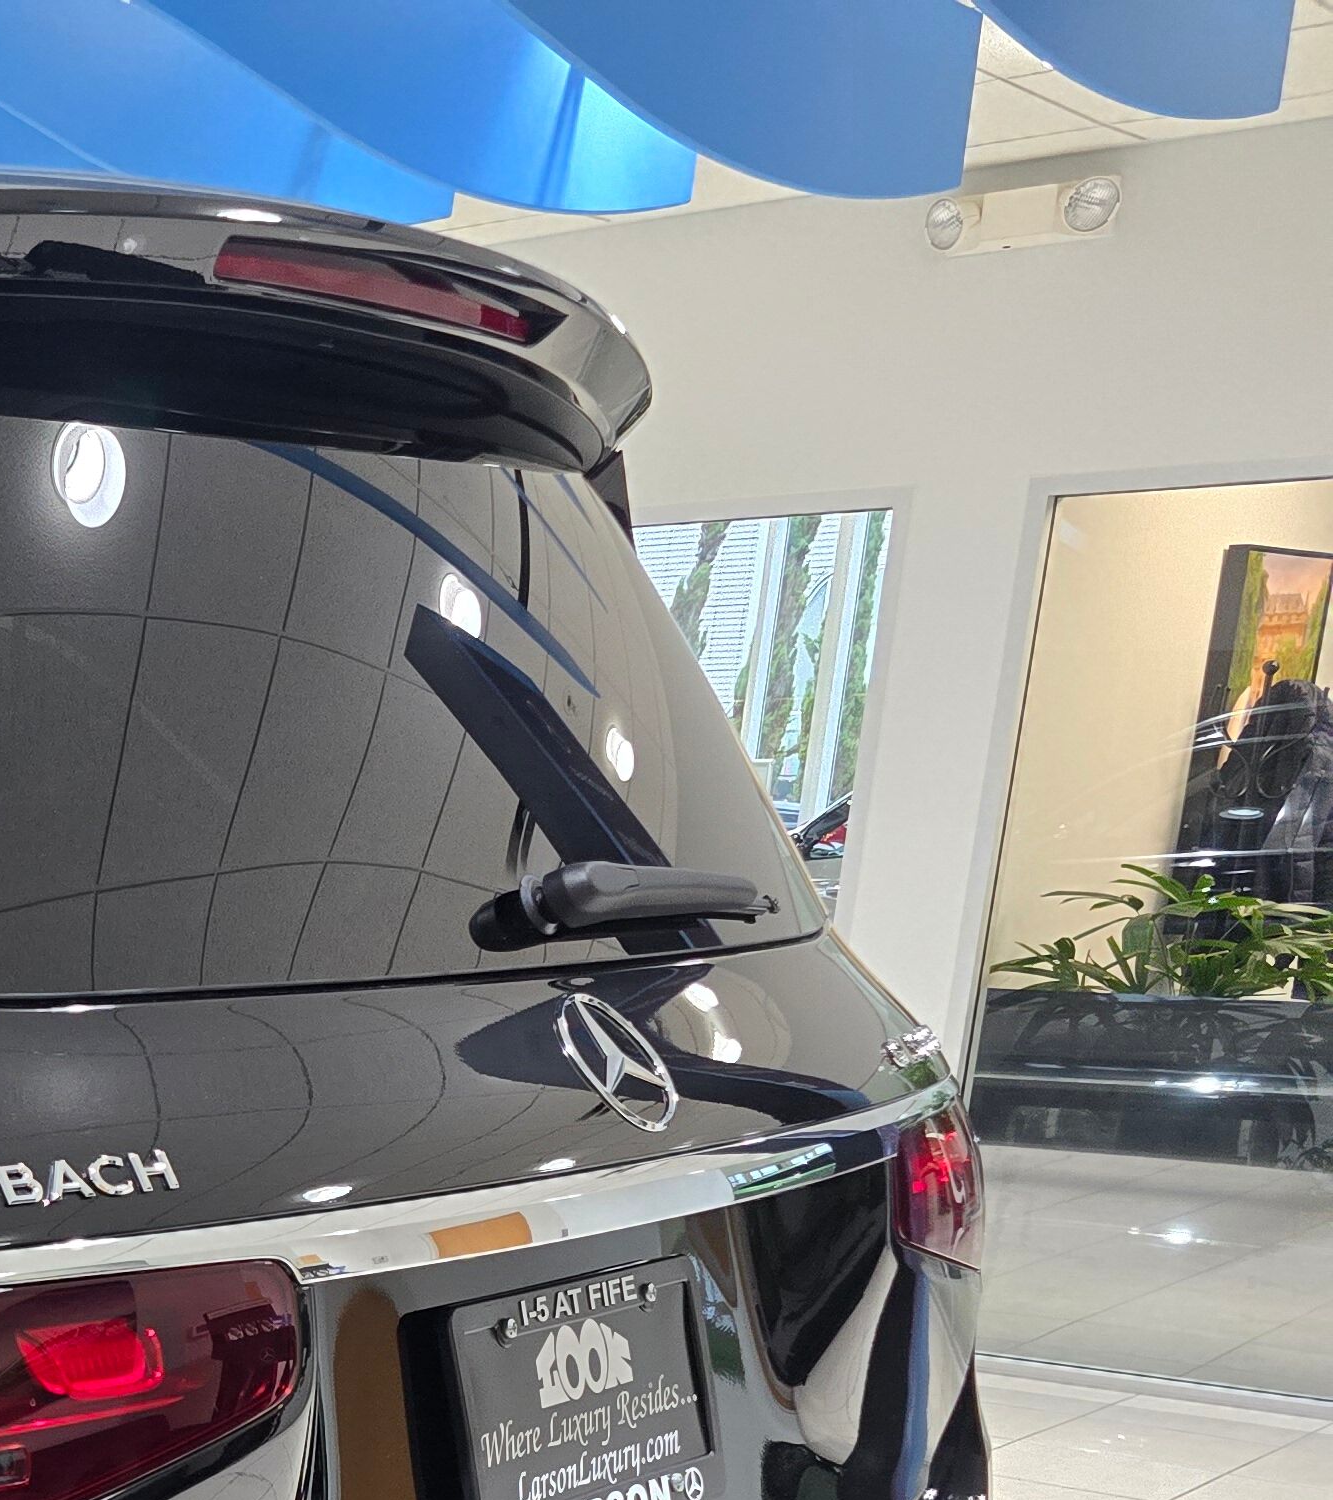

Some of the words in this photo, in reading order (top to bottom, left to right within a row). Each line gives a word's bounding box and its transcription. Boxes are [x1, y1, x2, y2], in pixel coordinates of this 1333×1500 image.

[520, 1295, 550, 1327] I-5
[555, 1287, 583, 1319] AT
[588, 1275, 638, 1310] FIFE
[481, 1420, 542, 1468] Where
[547, 1406, 611, 1446] Luxury
[617, 1374, 698, 1429] Resides...
